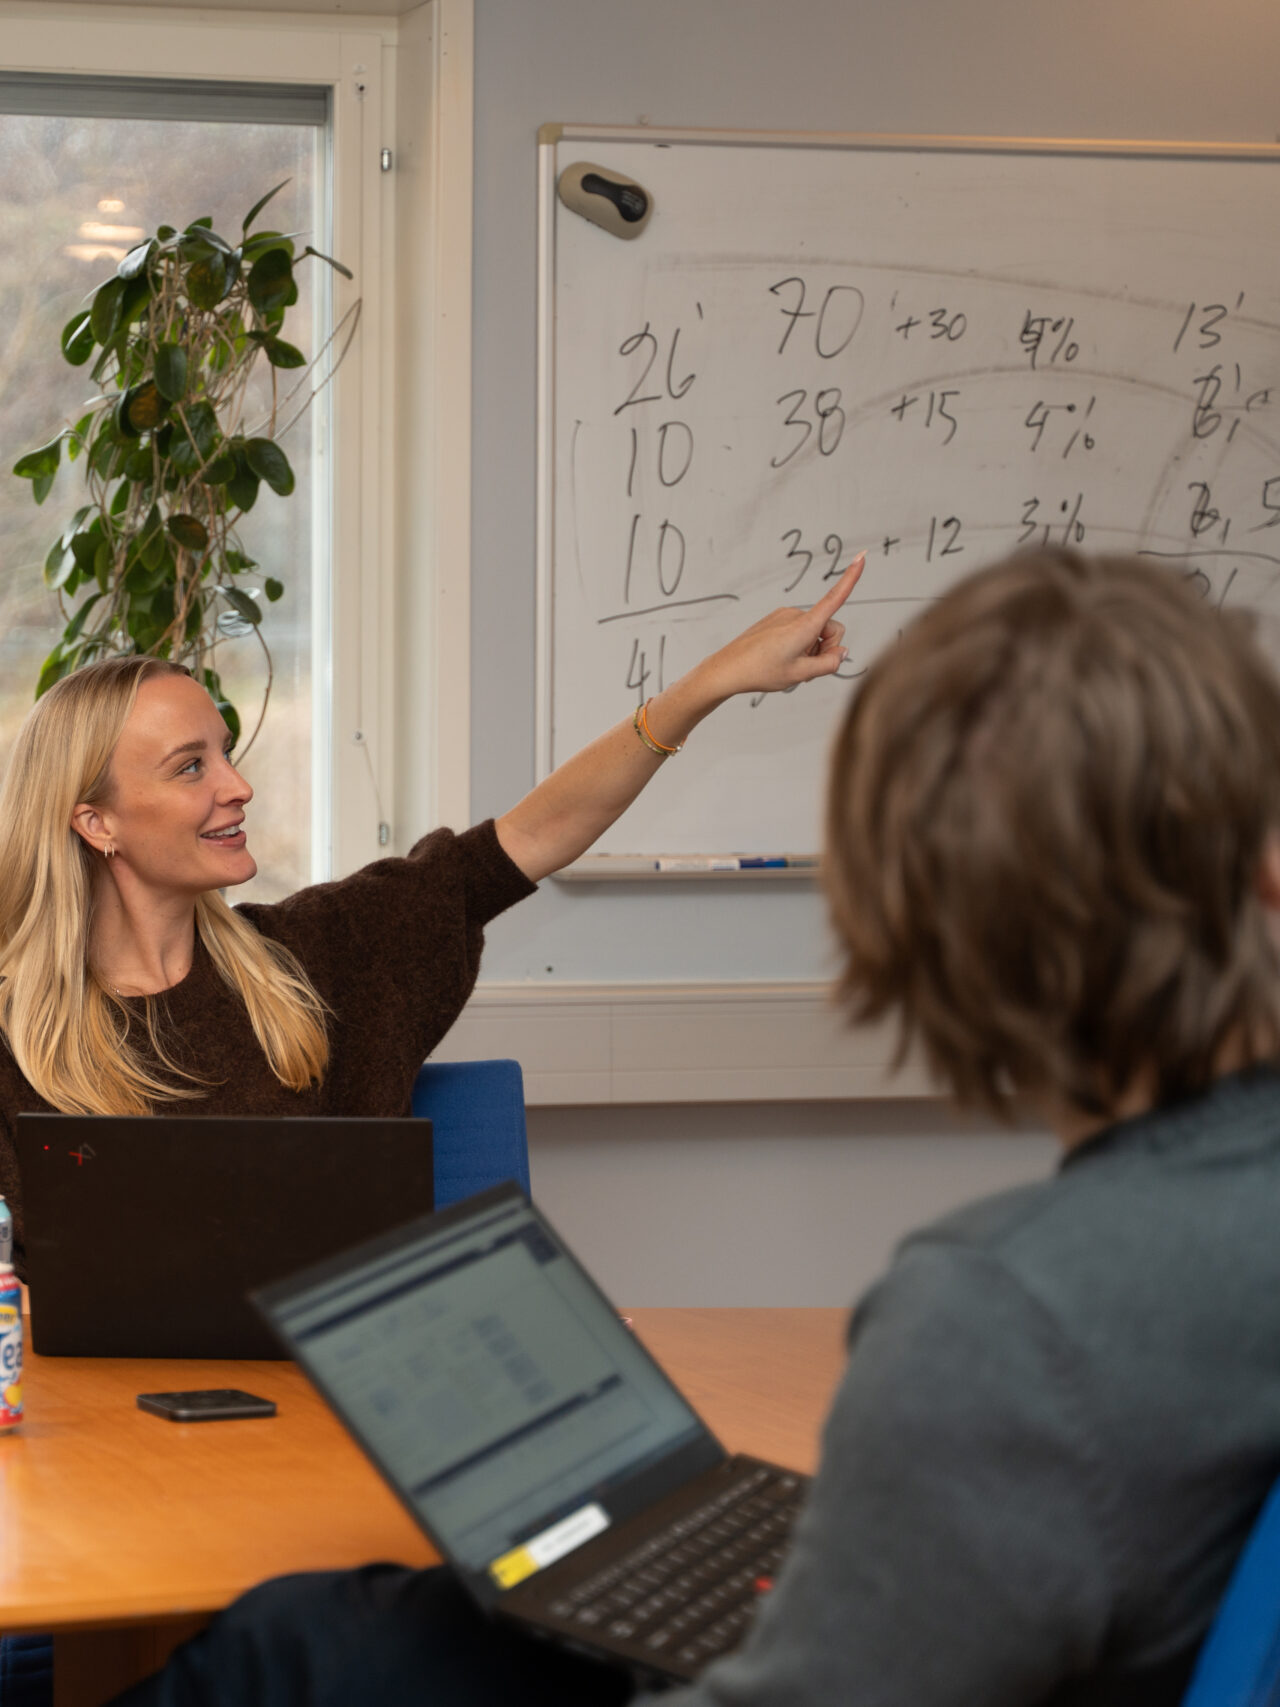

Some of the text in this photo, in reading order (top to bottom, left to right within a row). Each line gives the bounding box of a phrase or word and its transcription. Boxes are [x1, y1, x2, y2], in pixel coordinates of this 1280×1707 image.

[627, 420, 694, 497] 10
[770, 386, 846, 468] 38
[625, 514, 686, 604] 10
